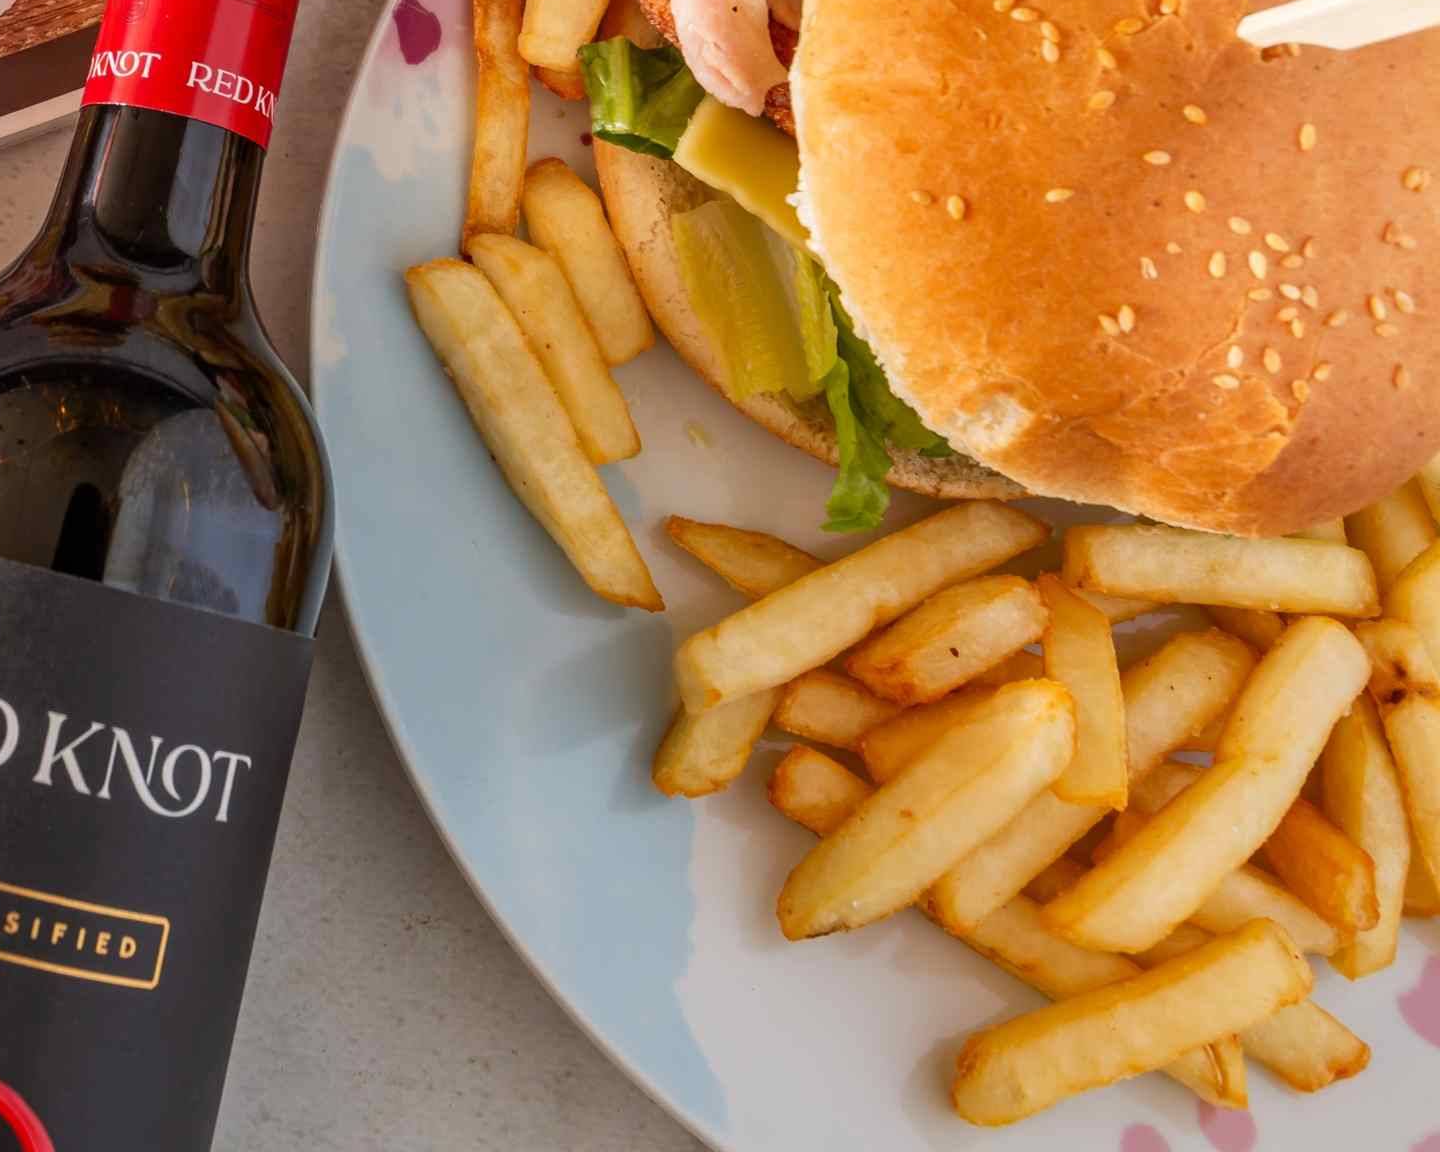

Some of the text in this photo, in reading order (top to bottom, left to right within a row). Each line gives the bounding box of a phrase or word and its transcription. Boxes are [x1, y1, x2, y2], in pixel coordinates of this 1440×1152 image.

[92, 51, 161, 79] KNOT
[186, 61, 253, 104] RED
[32, 710, 251, 823] KNOT
